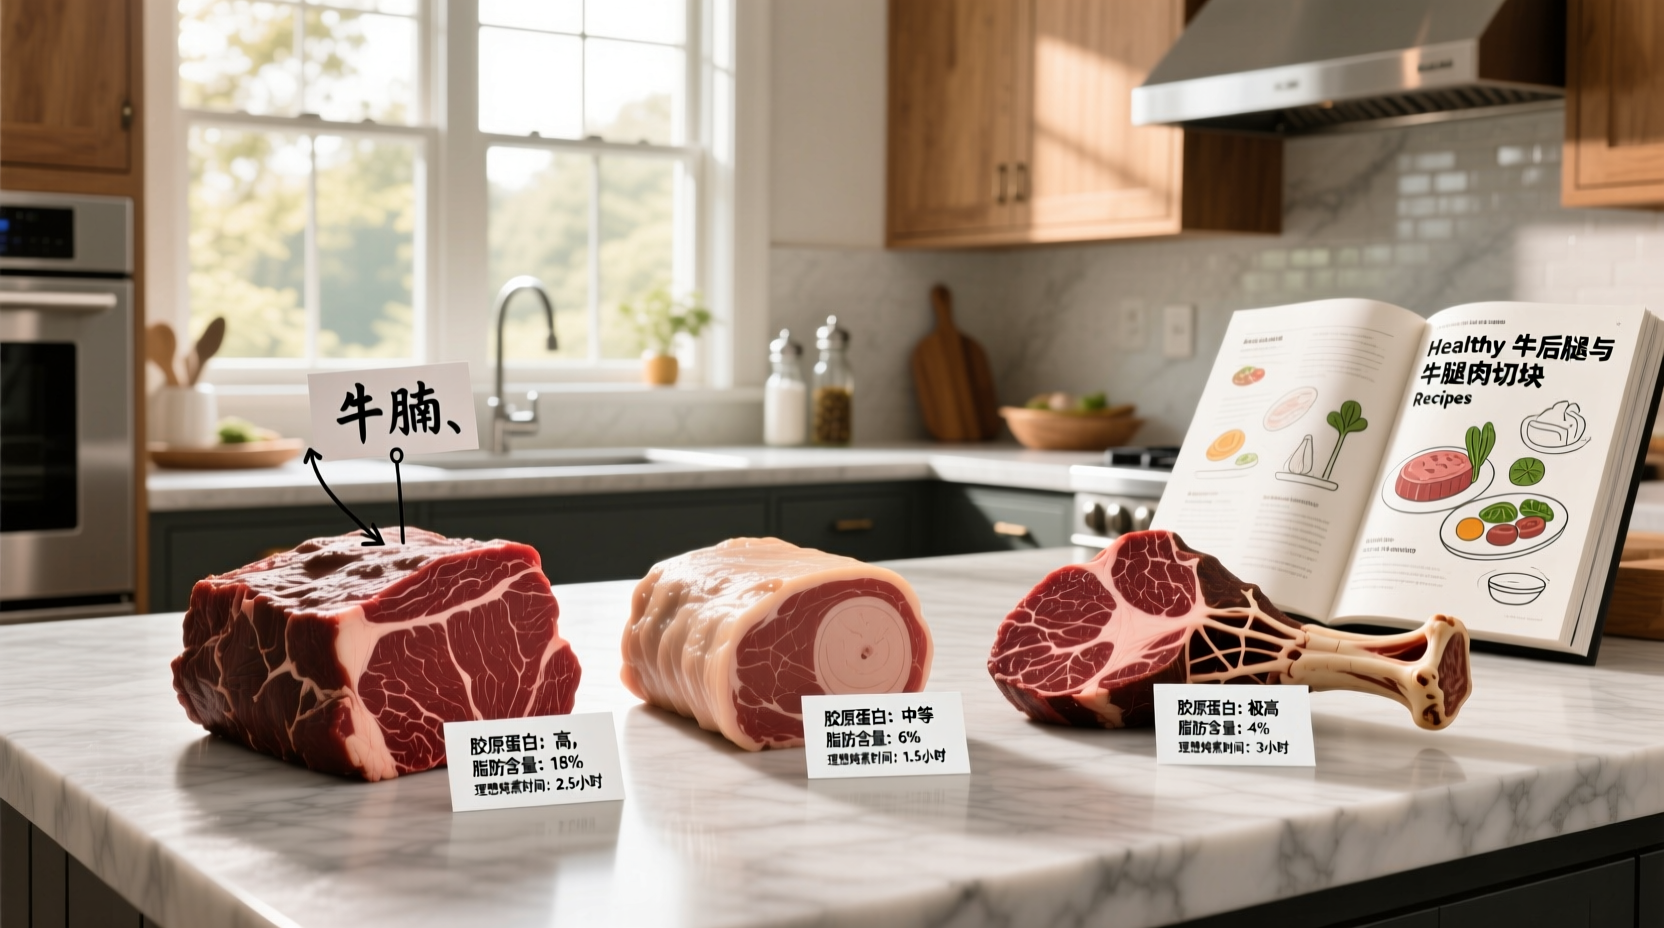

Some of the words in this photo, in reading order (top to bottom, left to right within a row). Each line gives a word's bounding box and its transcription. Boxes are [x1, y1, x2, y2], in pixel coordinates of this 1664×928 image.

[1427, 335, 1506, 359] Healthy
[1512, 333, 1616, 362] 牛后腿与
[1420, 361, 1545, 389] 牛腿肉切块
[1412, 389, 1473, 410] Recipes
